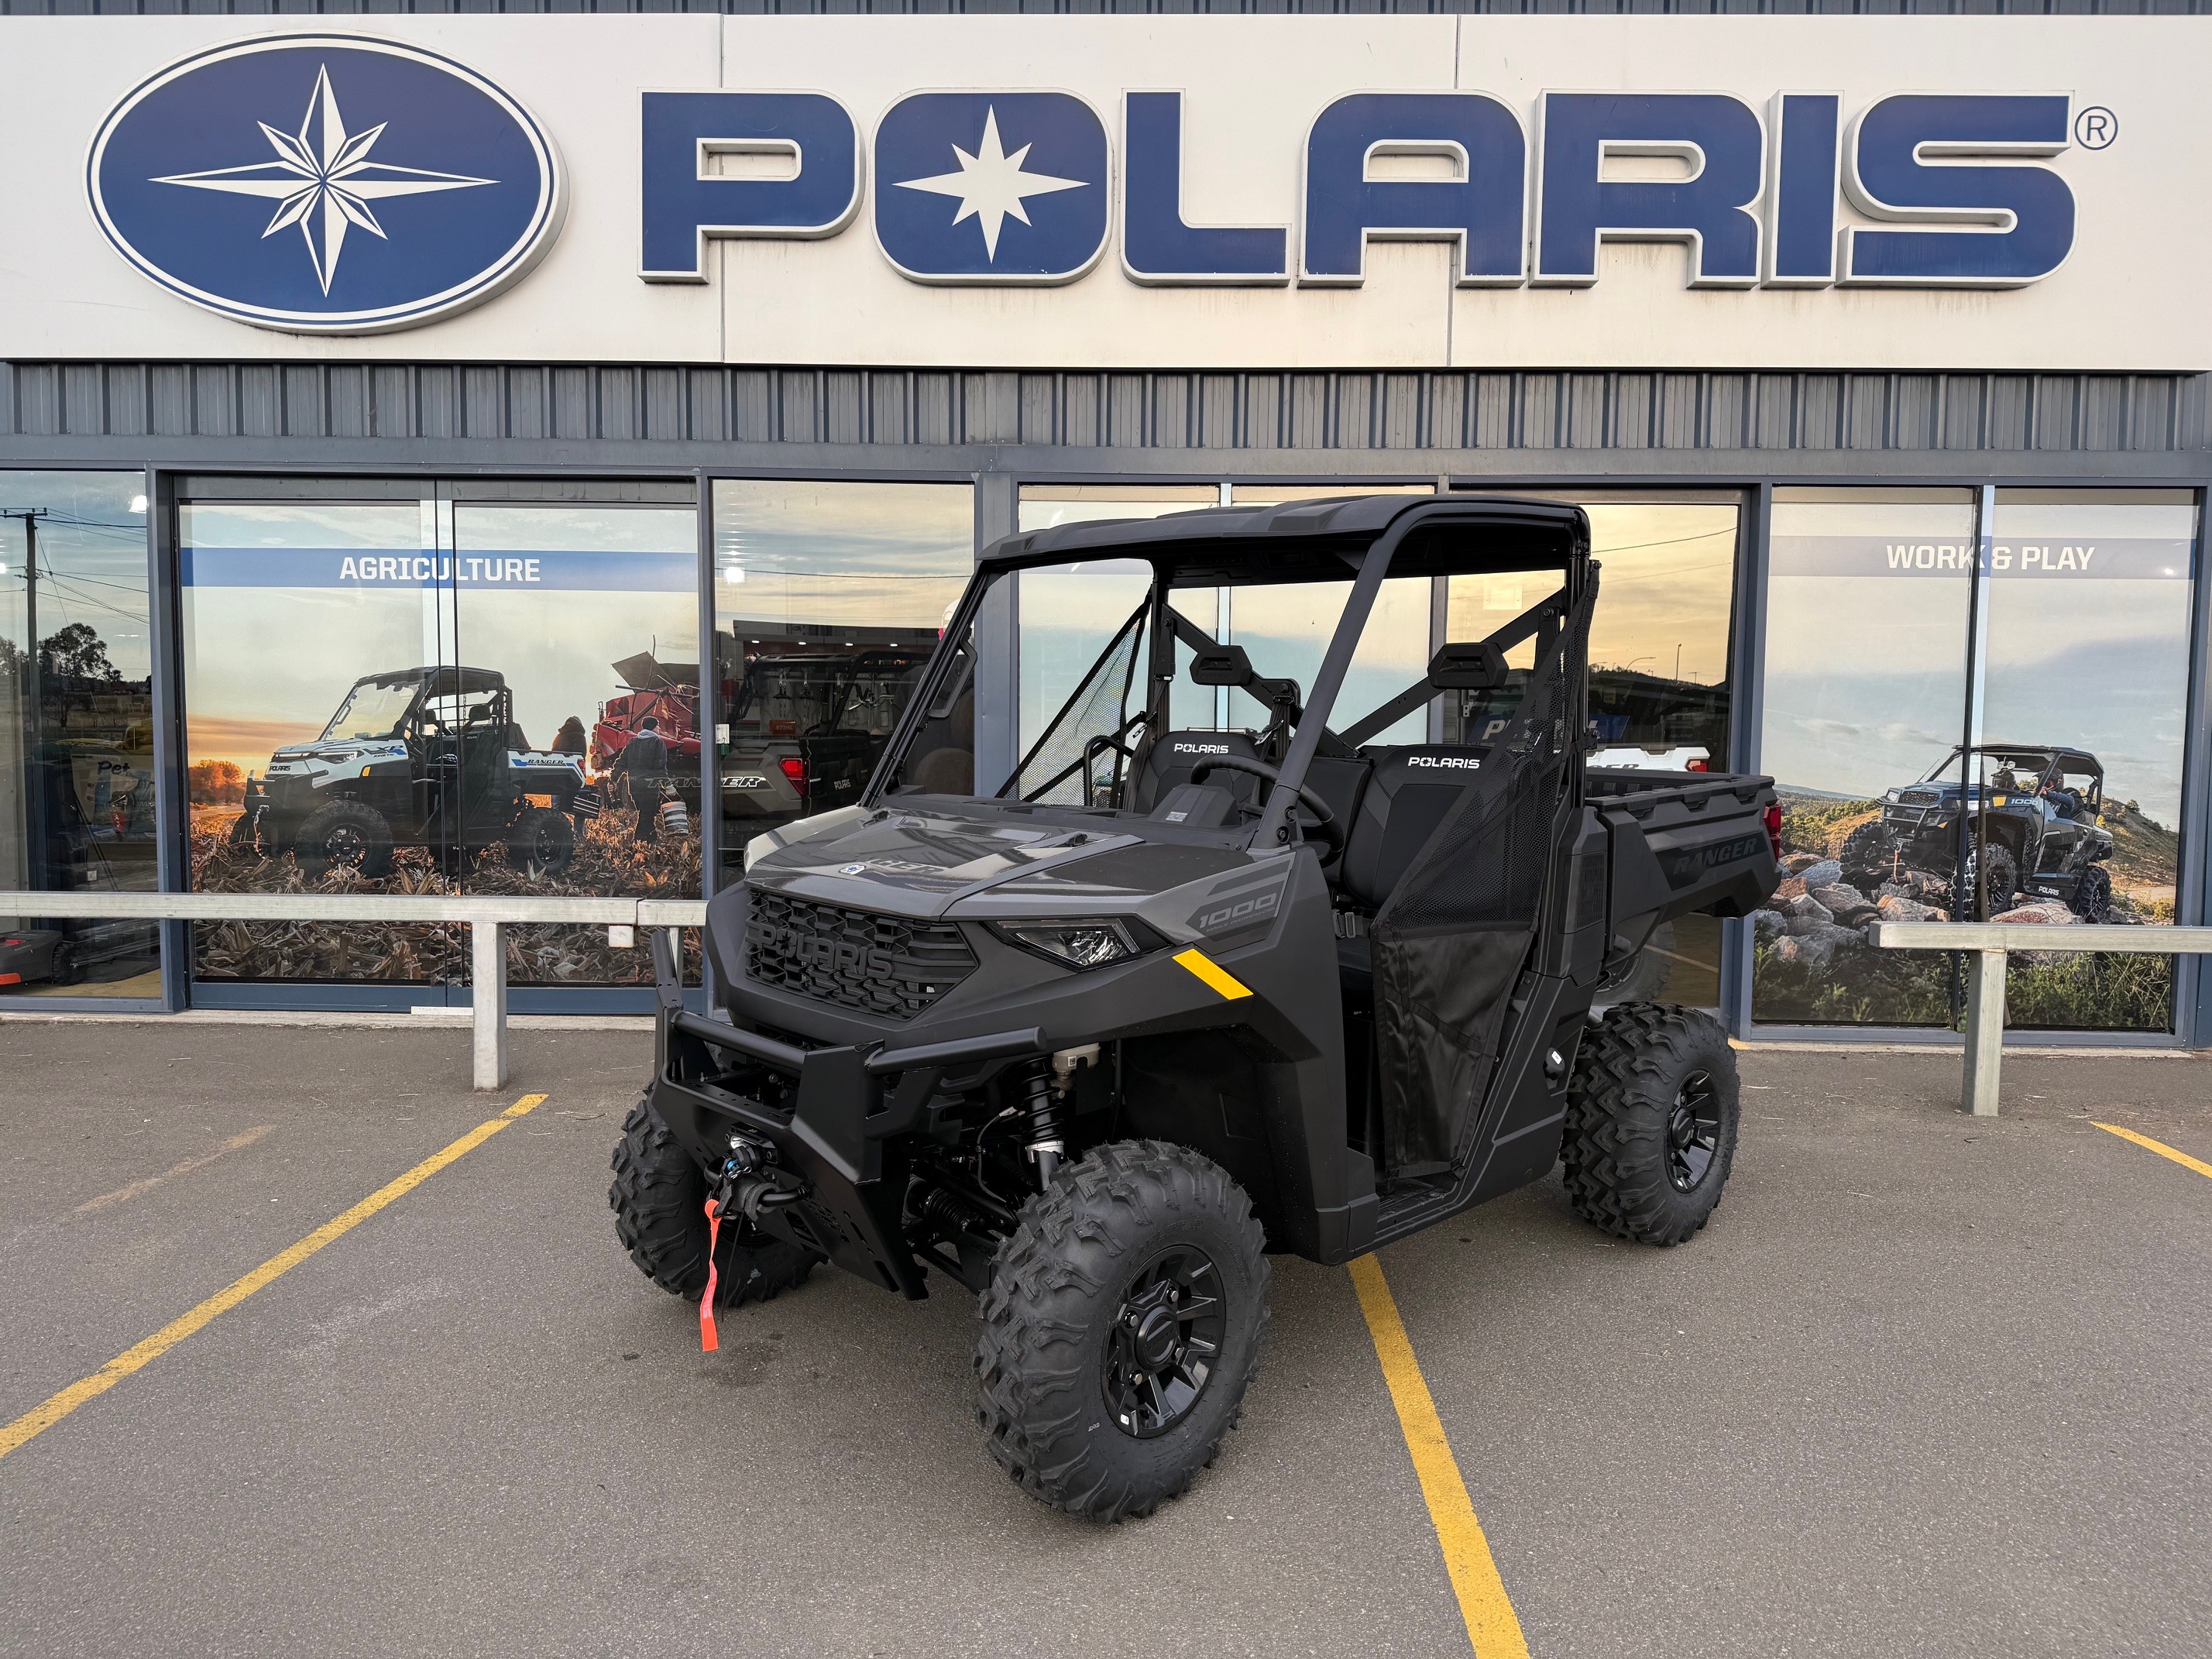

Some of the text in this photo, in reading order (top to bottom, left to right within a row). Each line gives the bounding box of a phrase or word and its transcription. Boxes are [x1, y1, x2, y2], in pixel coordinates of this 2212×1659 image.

[637, 88, 2082, 290] POLARIS
[1887, 544, 2096, 571] WORK & PLAY
[339, 556, 541, 582] AGRICULTURE
[1173, 743, 1230, 754] POLARIS
[98, 760, 131, 775] Pet
[1407, 756, 1481, 770] POLARIS
[645, 775, 763, 788] RANER
[833, 778, 852, 791] POLARIS
[1673, 838, 1757, 874] RANGER
[2038, 885, 2059, 897] POLARIS
[1199, 892, 1277, 929] 1000
[758, 922, 894, 981] POLARIS
